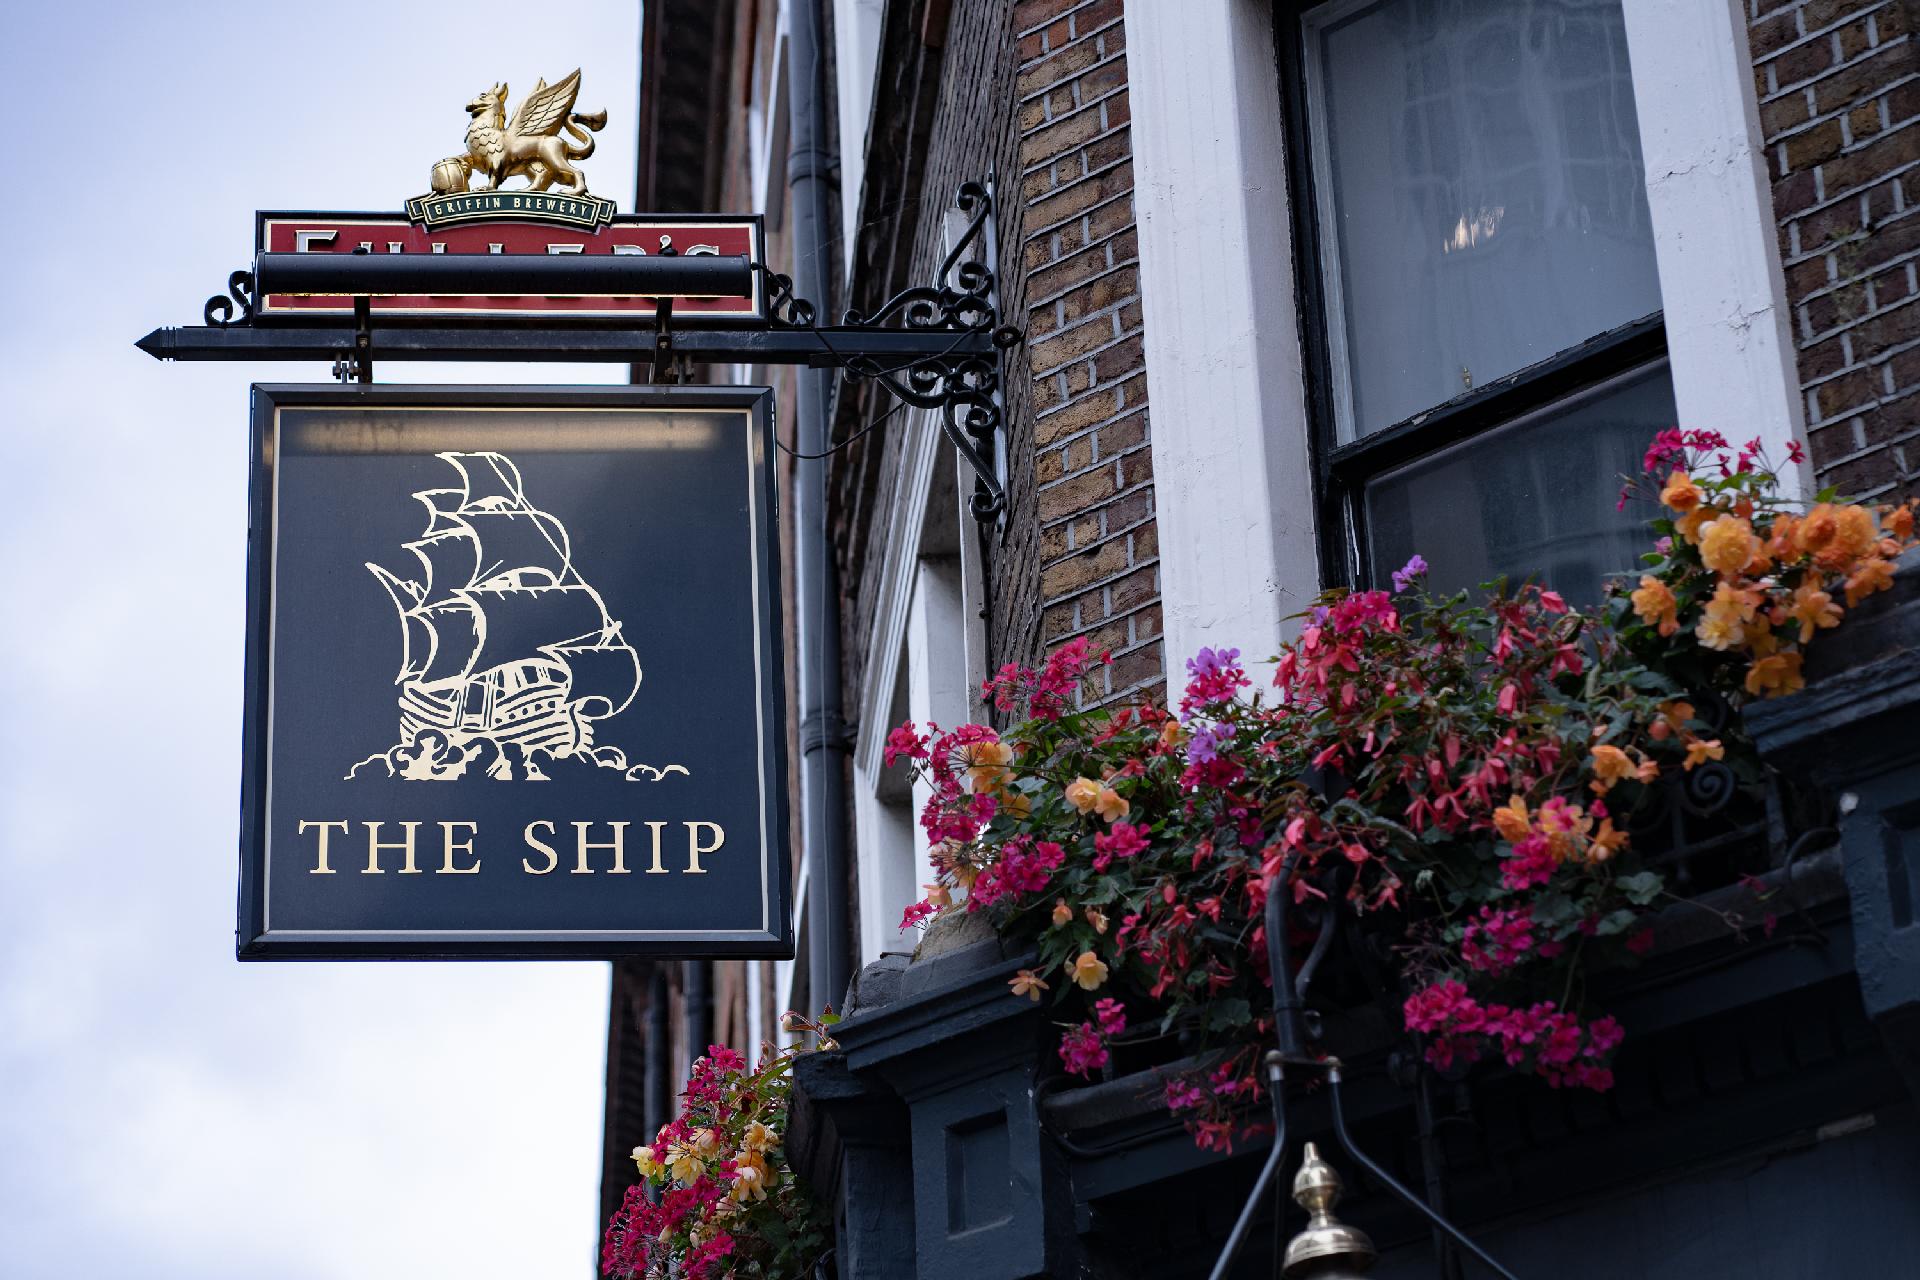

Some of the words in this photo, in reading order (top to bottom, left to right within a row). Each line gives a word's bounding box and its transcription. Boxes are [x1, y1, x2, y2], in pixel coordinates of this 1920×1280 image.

[435, 197, 501, 215] GRIFFIN
[513, 197, 588, 217] BREWERY
[298, 819, 482, 874] THE
[522, 819, 726, 875] SHIP
